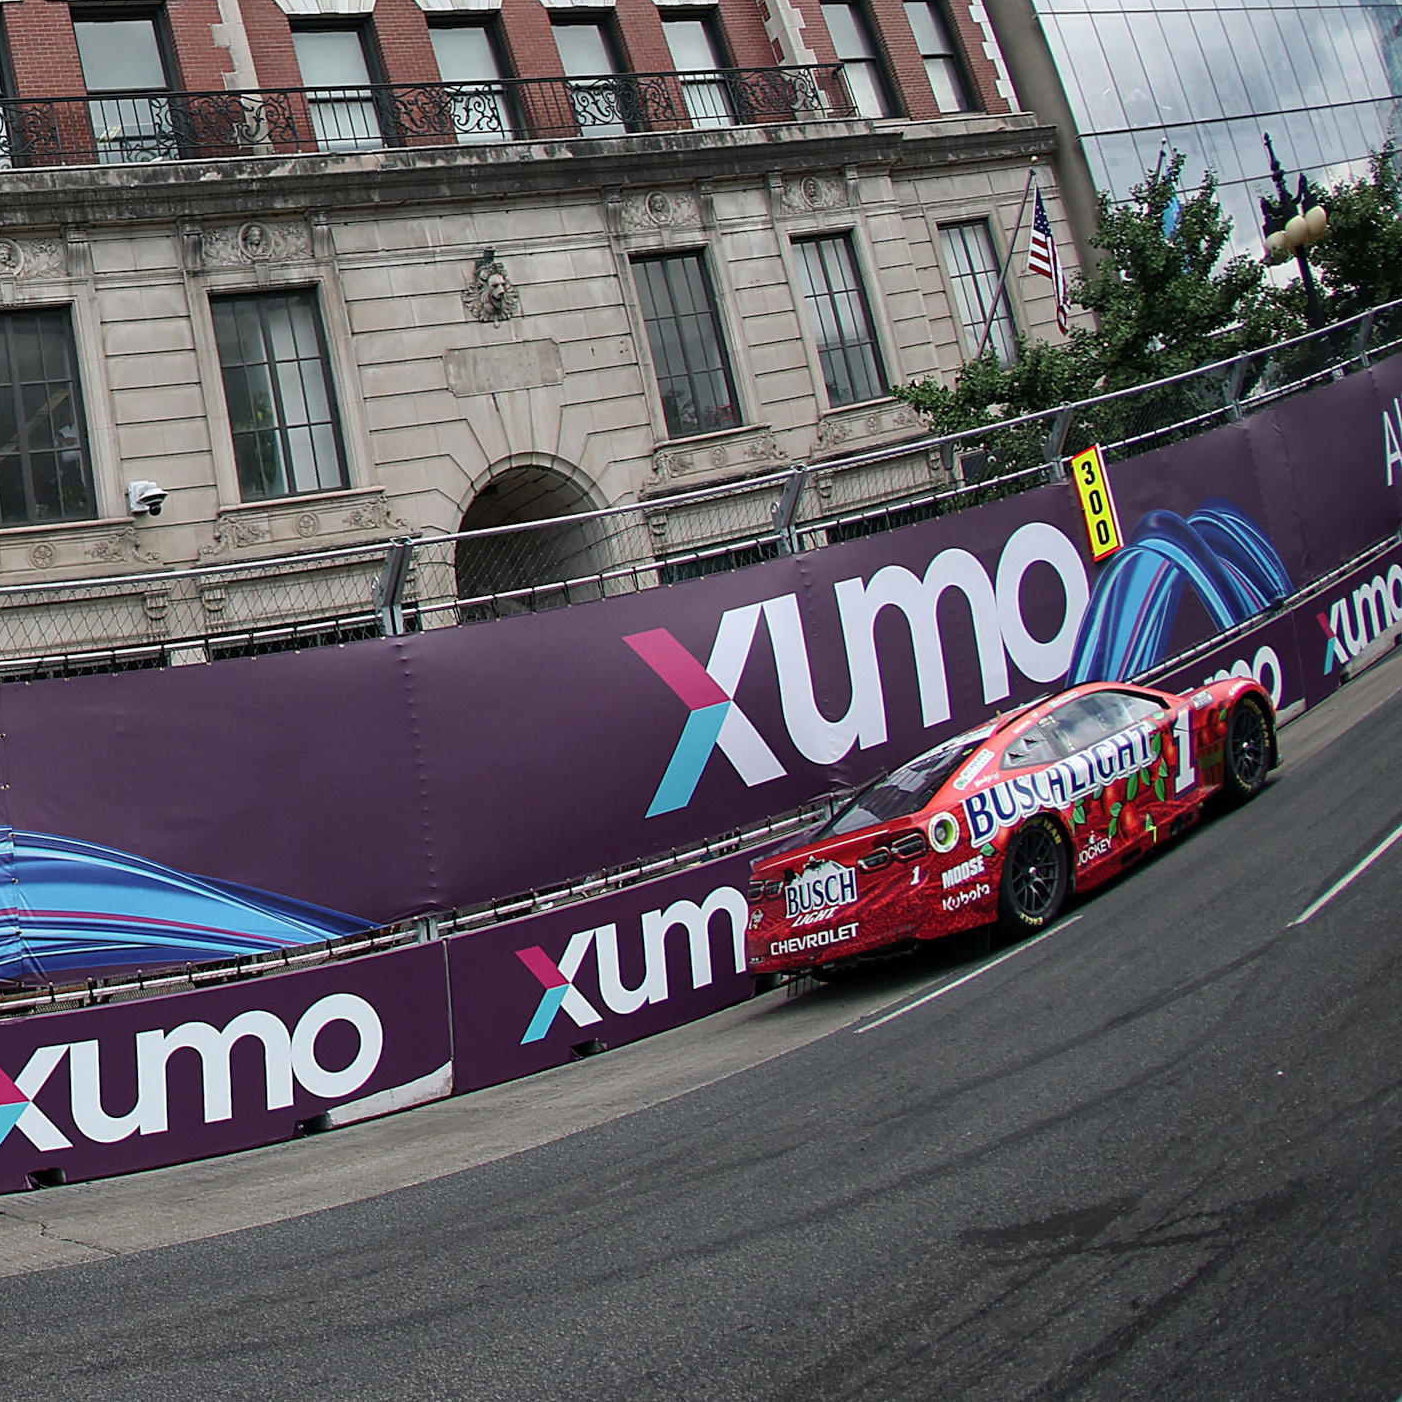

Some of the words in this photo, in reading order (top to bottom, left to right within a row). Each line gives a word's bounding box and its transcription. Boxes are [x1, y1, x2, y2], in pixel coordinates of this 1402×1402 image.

[1081, 460, 1110, 545] 300
[622, 522, 1090, 819] xumo
[1173, 708, 1196, 794] 1
[963, 762, 1071, 847] BUSCH
[1065, 719, 1163, 799] LIGHT
[941, 854, 986, 890] MOOSE
[1077, 835, 1113, 867] JOCKEY
[784, 867, 858, 919] BUSCH
[909, 865, 922, 886] 1
[941, 881, 991, 912] Kubota
[770, 921, 860, 956] CHEVROLET
[790, 905, 840, 928] LIGHT
[514, 884, 750, 1045] xum
